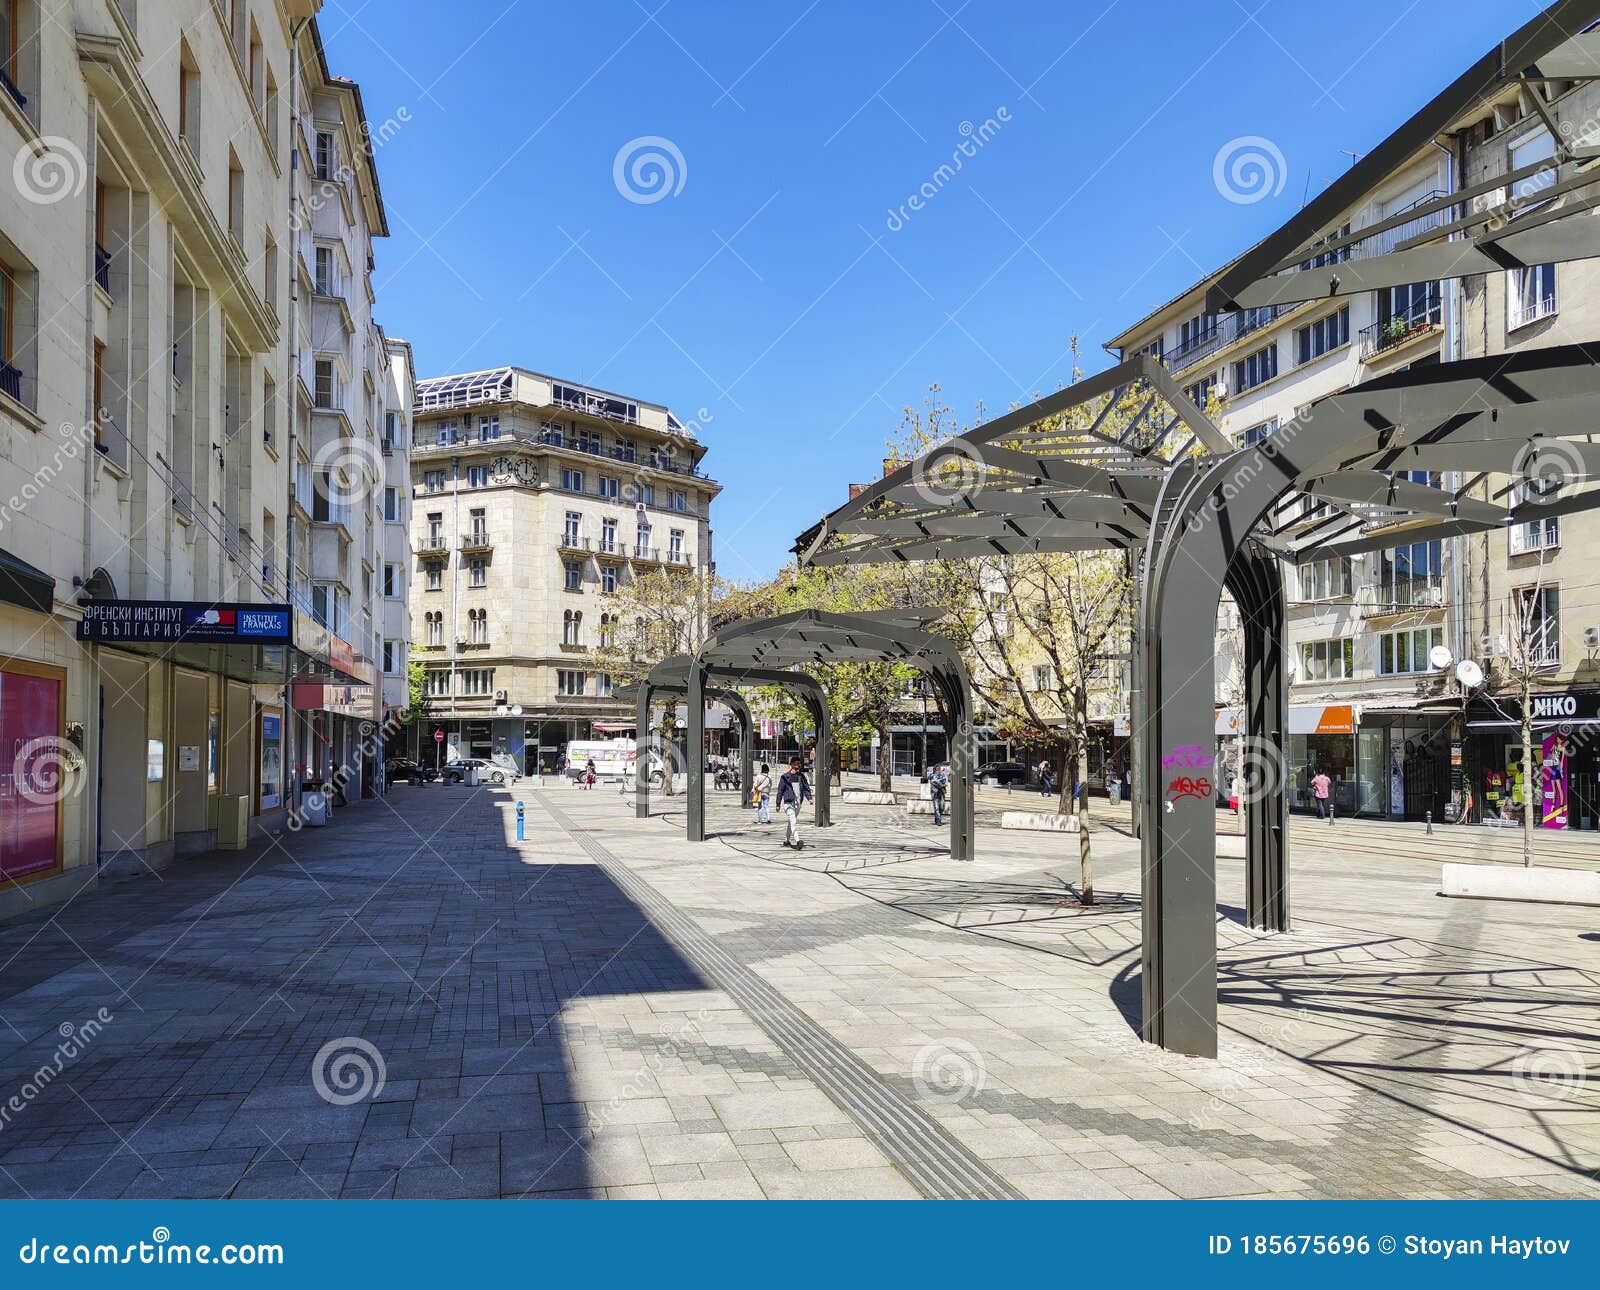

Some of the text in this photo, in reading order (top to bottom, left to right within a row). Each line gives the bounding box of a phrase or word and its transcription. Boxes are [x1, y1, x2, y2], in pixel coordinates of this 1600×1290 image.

[84, 605, 183, 621] ФРЕНСКИ ИНСТИТУТ
[243, 613, 278, 623] INSTITUT
[83, 621, 90, 635] В
[101, 621, 181, 637] БЪЛГАРИЯ
[1534, 696, 1577, 717] NIKO
[14, 738, 59, 760] CULTURE
